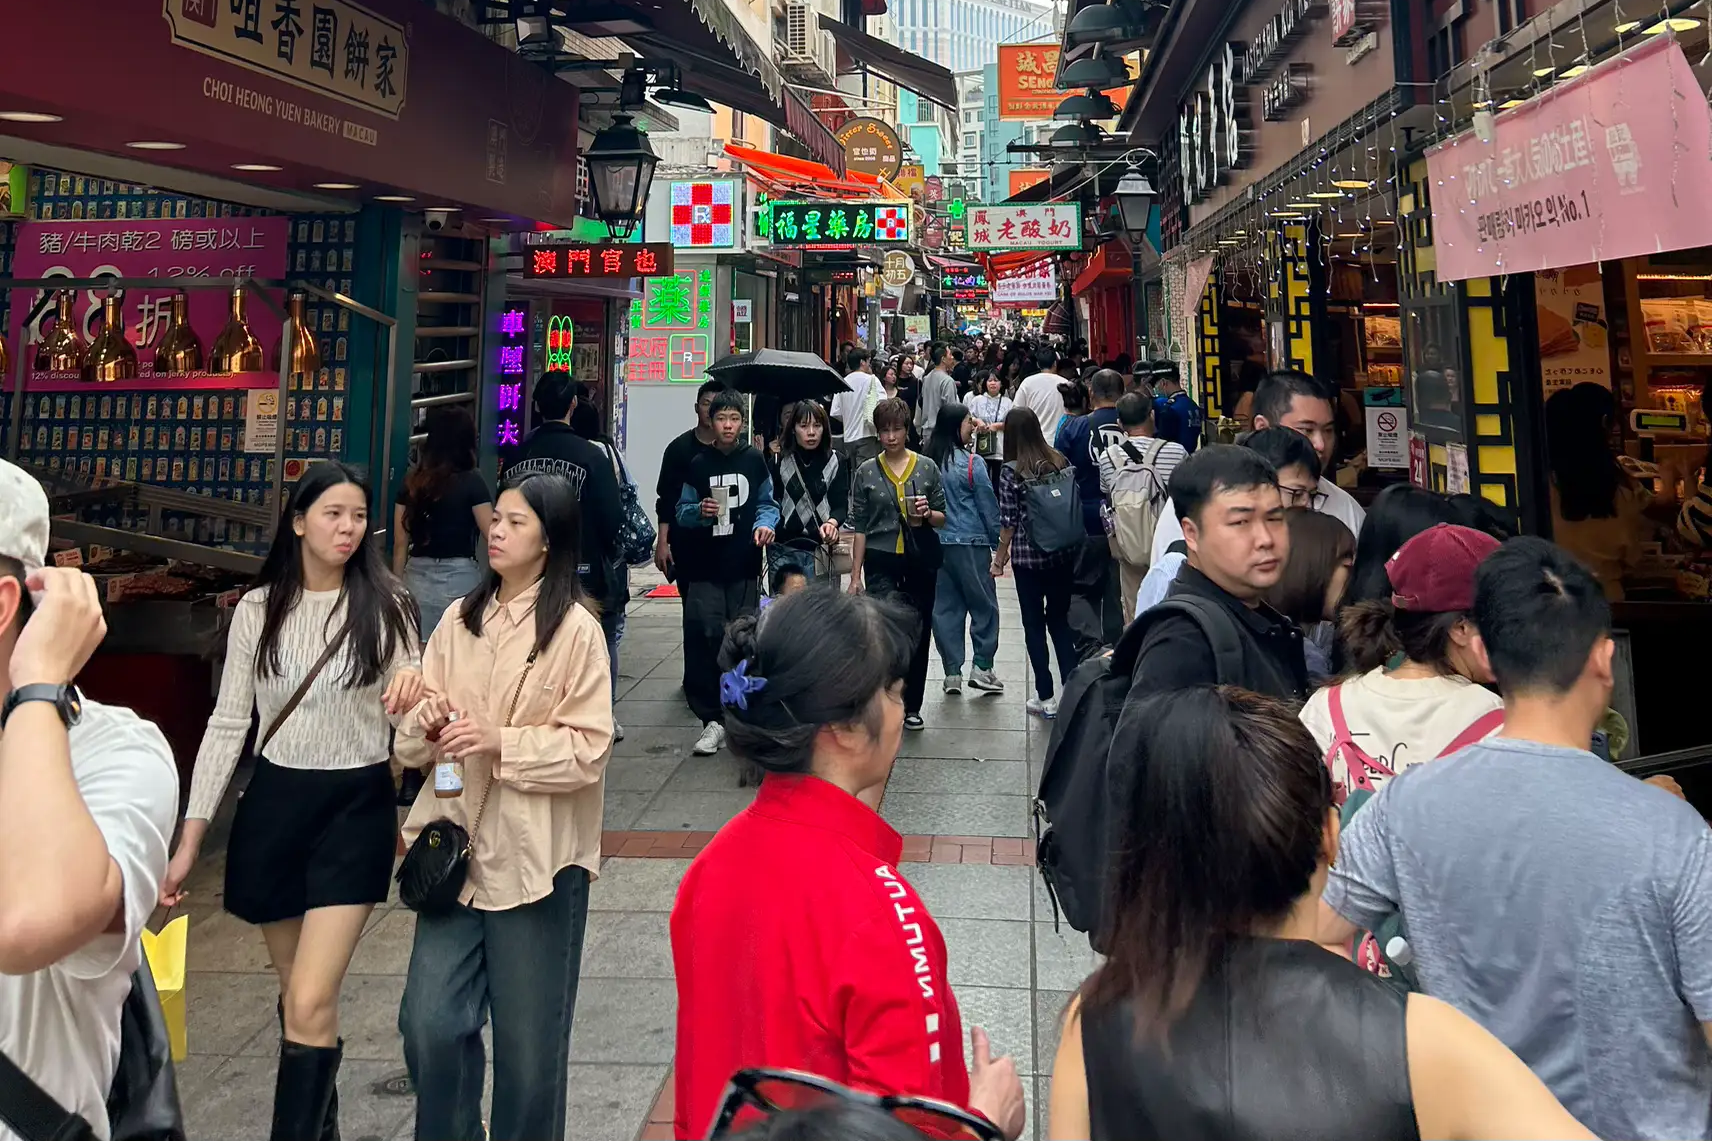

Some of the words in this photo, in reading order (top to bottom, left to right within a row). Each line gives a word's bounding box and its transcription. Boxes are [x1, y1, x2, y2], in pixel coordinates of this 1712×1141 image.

[203, 77, 234, 104] CHOI
[235, 88, 273, 115] HEONG
[275, 99, 302, 124] YUEN
[304, 108, 342, 135] BAKERY
[345, 123, 376, 144] MACAU
[775, 208, 875, 240] 福星藥房
[1016, 207, 1056, 218] 澳門
[973, 210, 992, 244] 鳳城
[997, 218, 1073, 240] 老酸奶
[40, 230, 162, 255] 豬/牛肉乾2
[171, 228, 265, 250] 磅或以上
[533, 248, 657, 274] 澳門官也
[629, 337, 668, 358] 政府
[31, 372, 49, 380] 12%
[51, 371, 80, 380] discou
[628, 361, 666, 381] 註冊
[709, 473, 750, 537] P
